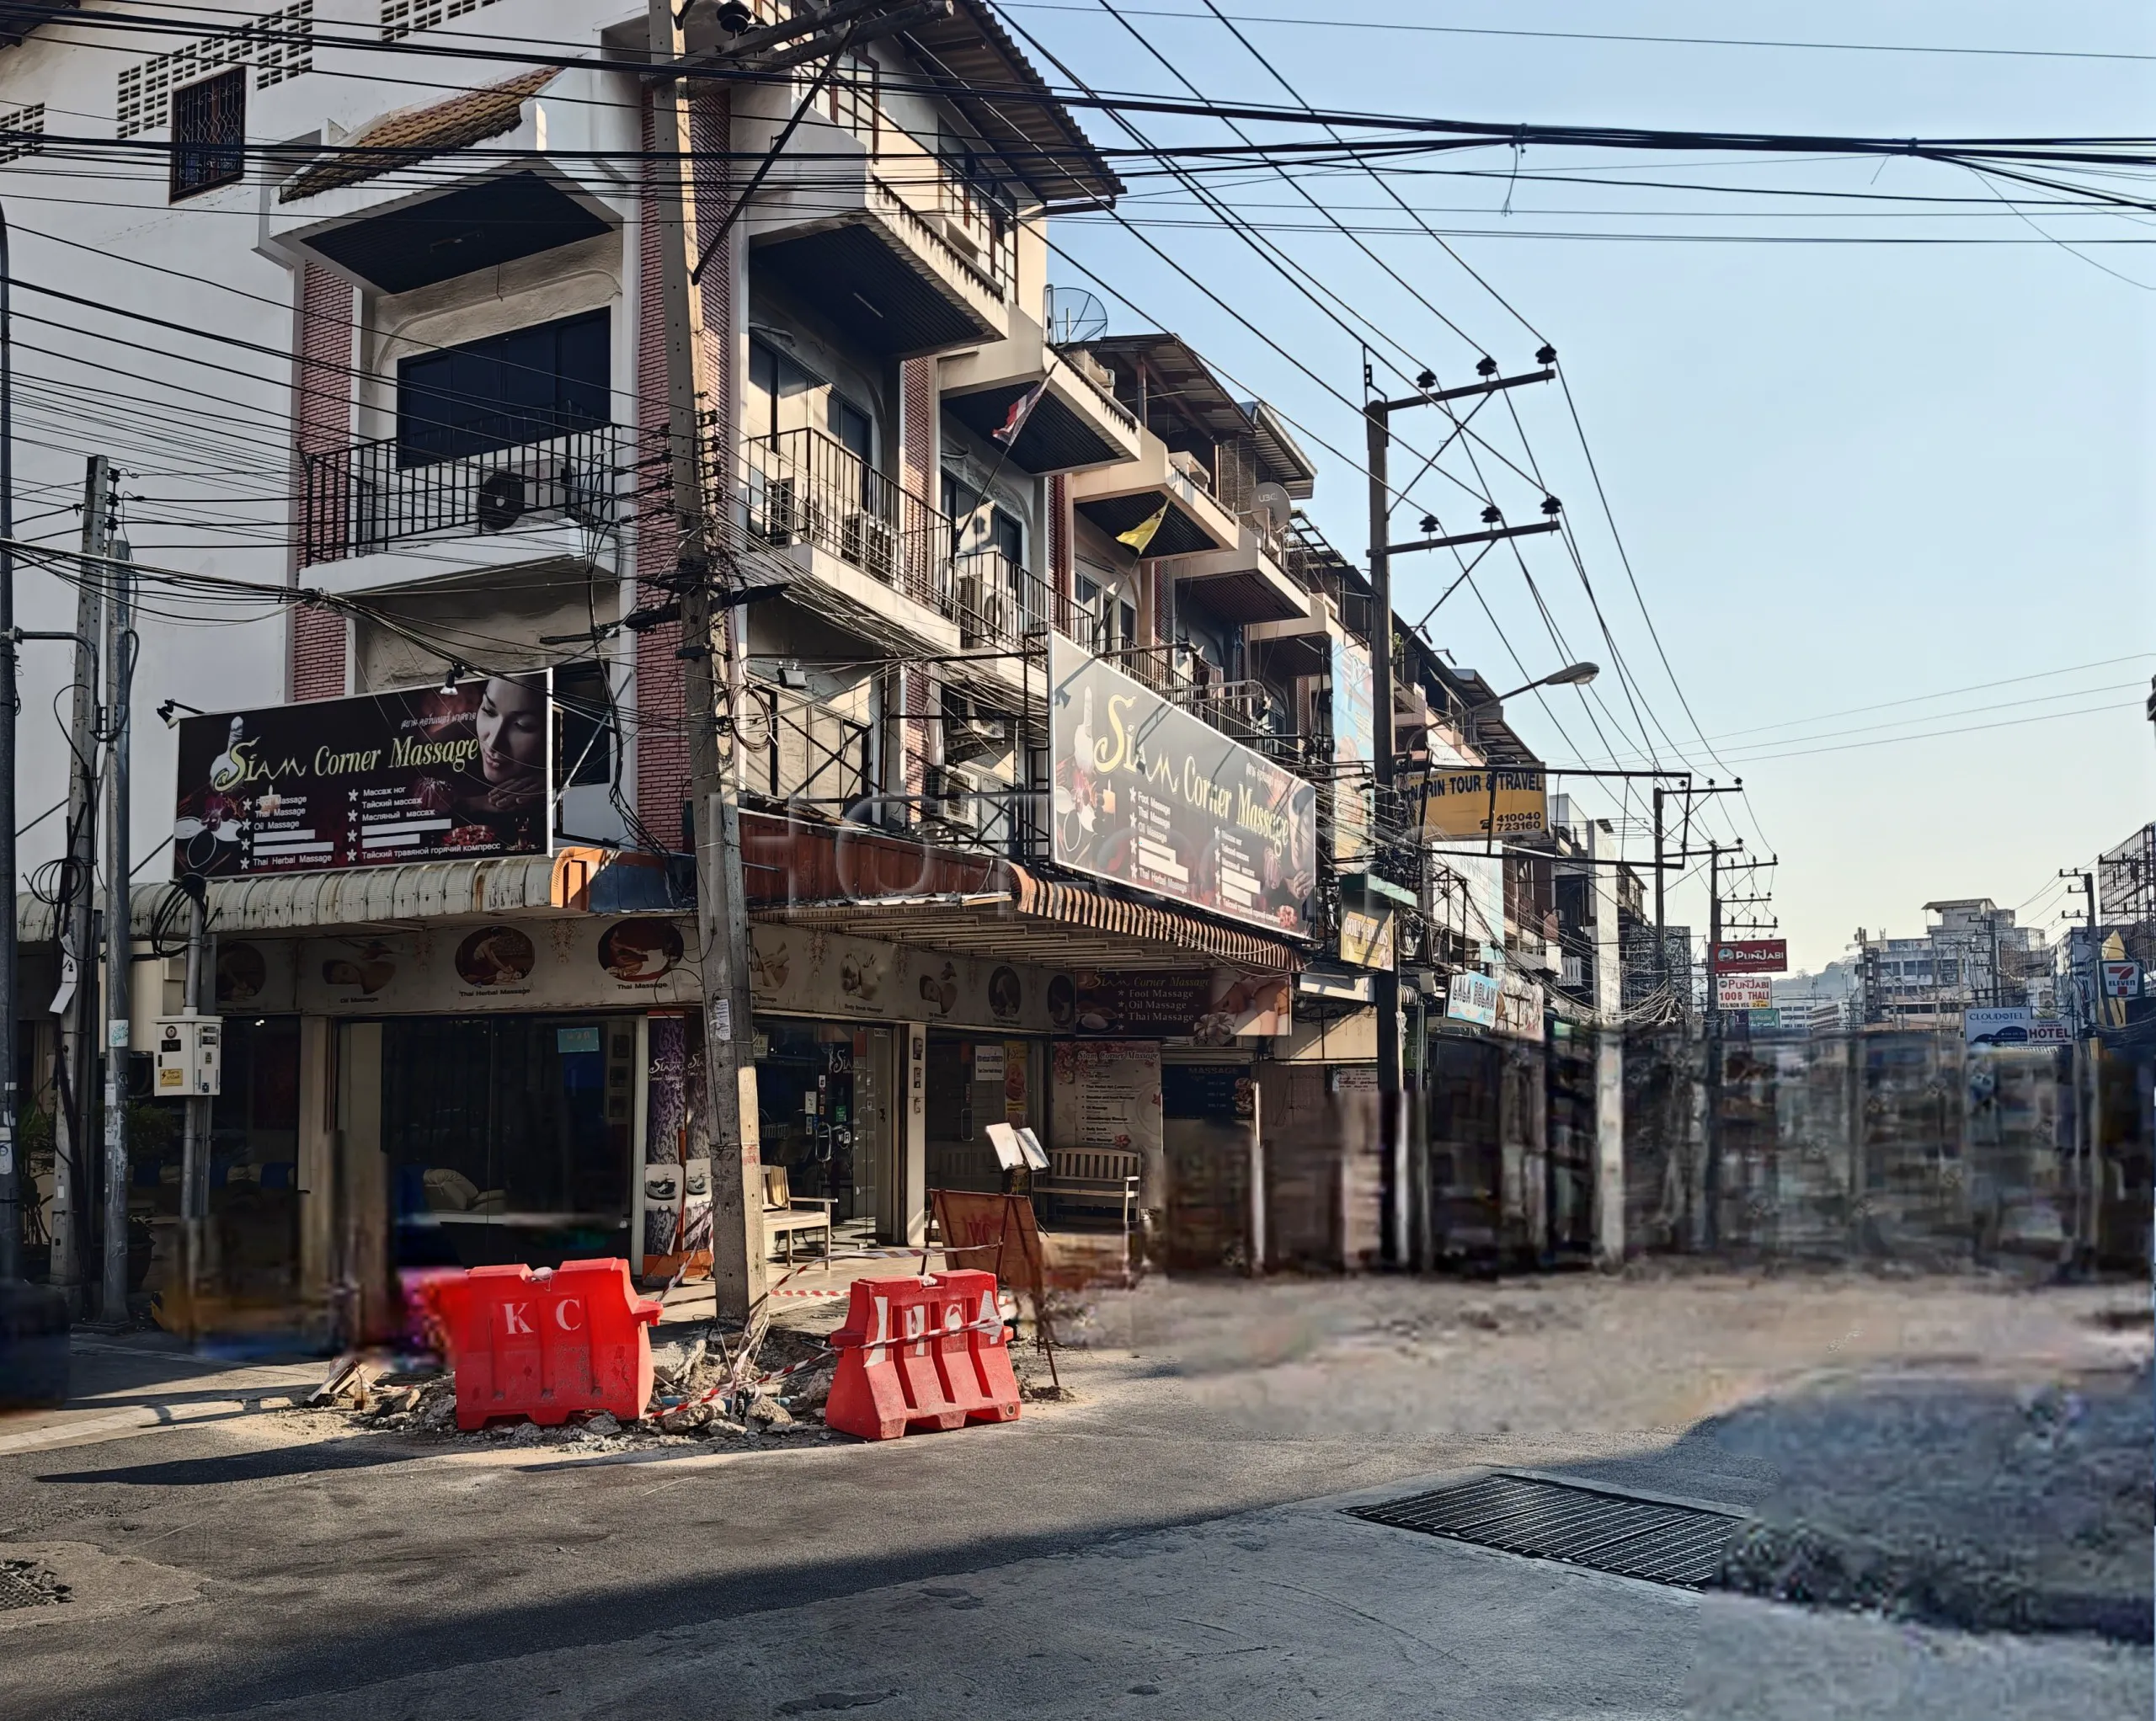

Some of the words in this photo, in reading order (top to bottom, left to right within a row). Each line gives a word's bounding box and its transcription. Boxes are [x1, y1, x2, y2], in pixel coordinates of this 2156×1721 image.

[315, 745, 382, 776] Corner
[388, 736, 478, 772] Massage
[1449, 775, 1481, 795] TOUR
[1486, 774, 1492, 791] &
[1497, 773, 1543, 791] TRAVEL
[363, 788, 392, 797] Массаж
[275, 796, 307, 806] Massage
[361, 800, 392, 809] Тайский
[394, 797, 423, 807] массаж
[1183, 754, 1232, 819] Corner
[1235, 781, 1289, 856] Massage
[274, 807, 306, 817] Massage
[362, 812, 400, 822] Масляный
[406, 808, 435, 818] массаж
[1497, 812, 1541, 823] 410040
[268, 820, 300, 829] Massage
[1497, 821, 1541, 832] 723160
[361, 850, 392, 860] Тайский
[394, 846, 430, 857] травяной
[430, 845, 462, 855] горячий
[463, 843, 501, 854] компресс
[253, 858, 269, 866] Thai
[272, 855, 296, 865] Herbal
[299, 854, 332, 864] Massage
[635, 982, 668, 990] Massage
[1134, 977, 1166, 987] Corner
[1129, 989, 1149, 998] Foot
[1152, 989, 1193, 999] Massage
[1748, 991, 1769, 1000] THALI
[1129, 1000, 1142, 1009] Oil
[1145, 1000, 1187, 1010] Massage
[1128, 1012, 1150, 1020] Thai
[1153, 1012, 1194, 1022] Massage
[2029, 1028, 2071, 1038] HOTEL
[1099, 1050, 1125, 1060] Corner
[1127, 1050, 1159, 1063] Massage
[502, 1302, 535, 1335] K
[556, 1299, 582, 1331] C
